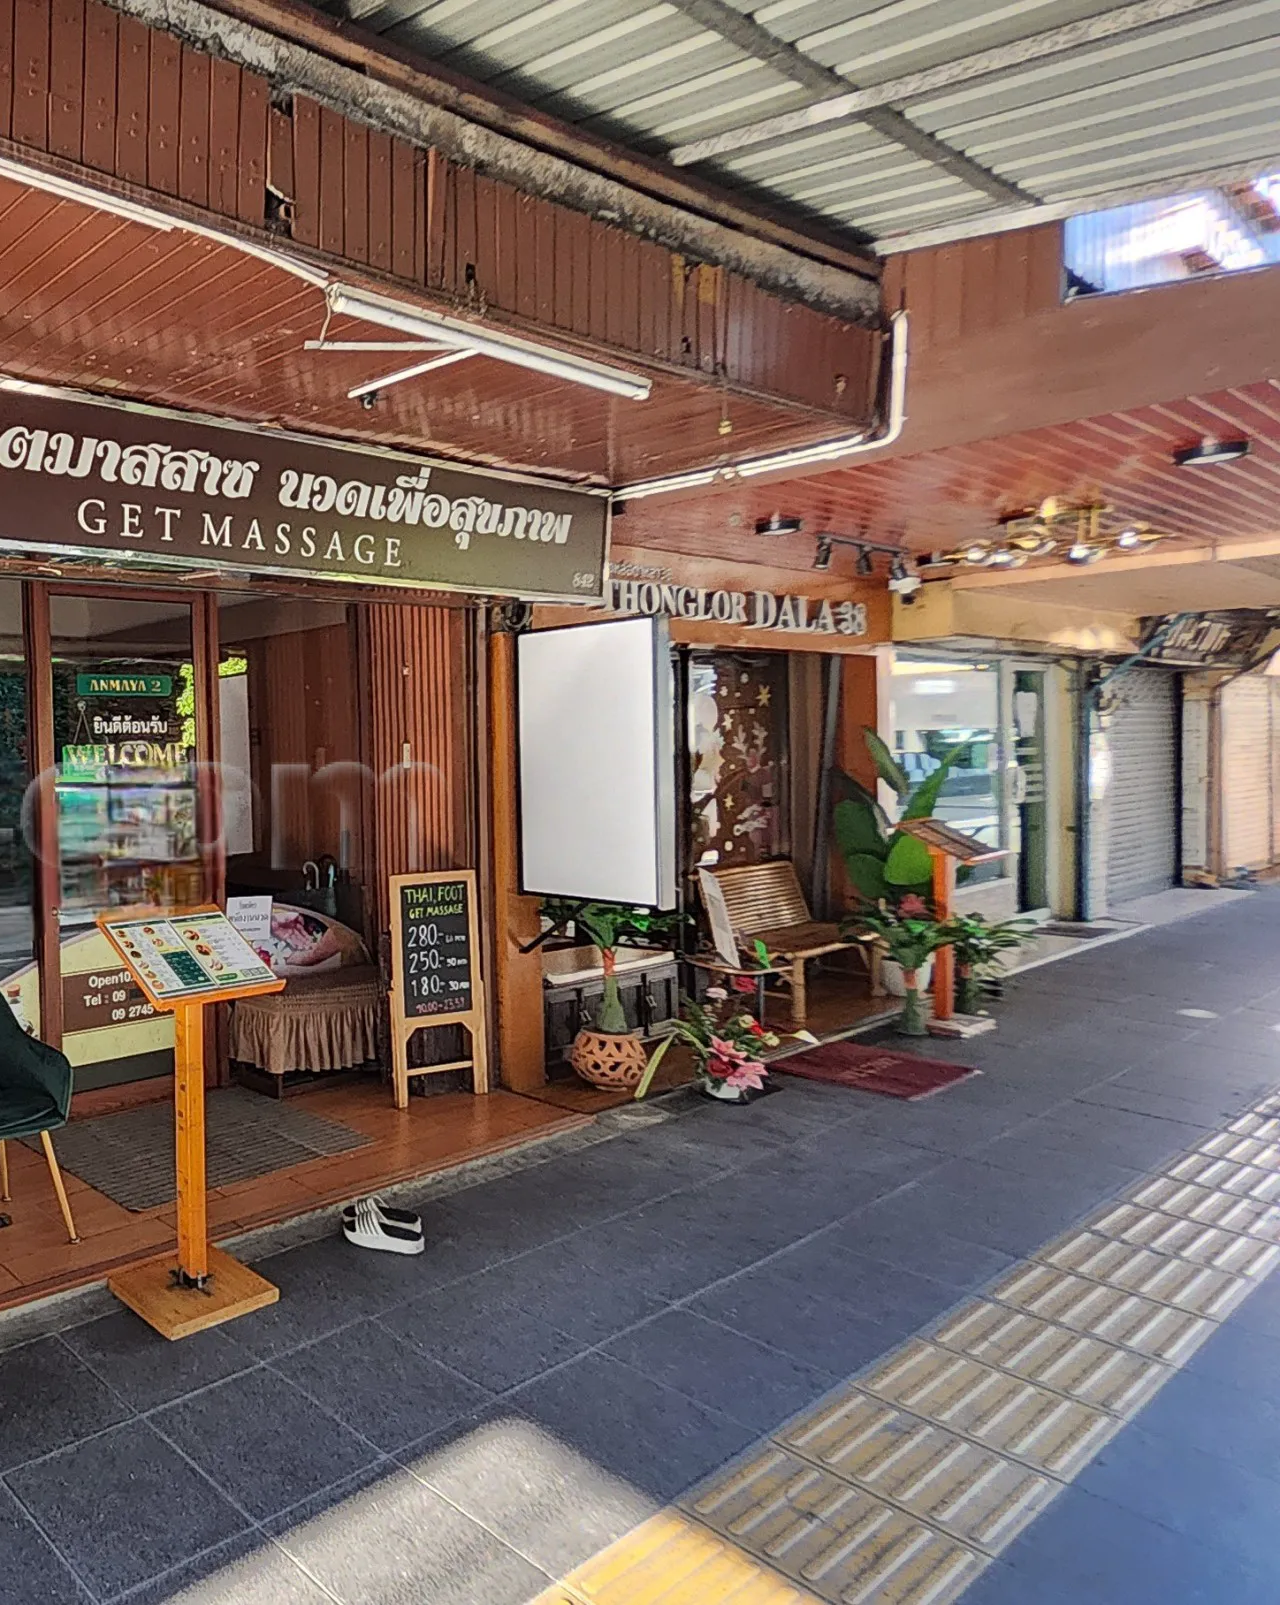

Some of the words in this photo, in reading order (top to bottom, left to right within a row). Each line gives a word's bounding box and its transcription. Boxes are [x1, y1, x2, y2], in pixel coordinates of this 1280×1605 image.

[278, 467, 572, 550] นวดเพื่อสุขภาพ
[77, 499, 181, 541] GET
[200, 513, 402, 567] MASSAGE
[752, 590, 839, 634] DALA
[90, 679, 146, 691] ANMAYA
[151, 680, 161, 691] 2
[93, 715, 168, 734] ยินดีต้อนรับ
[64, 743, 188, 767] WELCOME
[438, 884, 464, 901] FOOT
[409, 907, 423, 919] GET
[426, 904, 463, 916] MASSAGE
[83, 994, 102, 1007] Tel
[112, 990, 126, 1003] 09
[112, 1008, 126, 1020] 09
[128, 1003, 154, 1018] 2745
